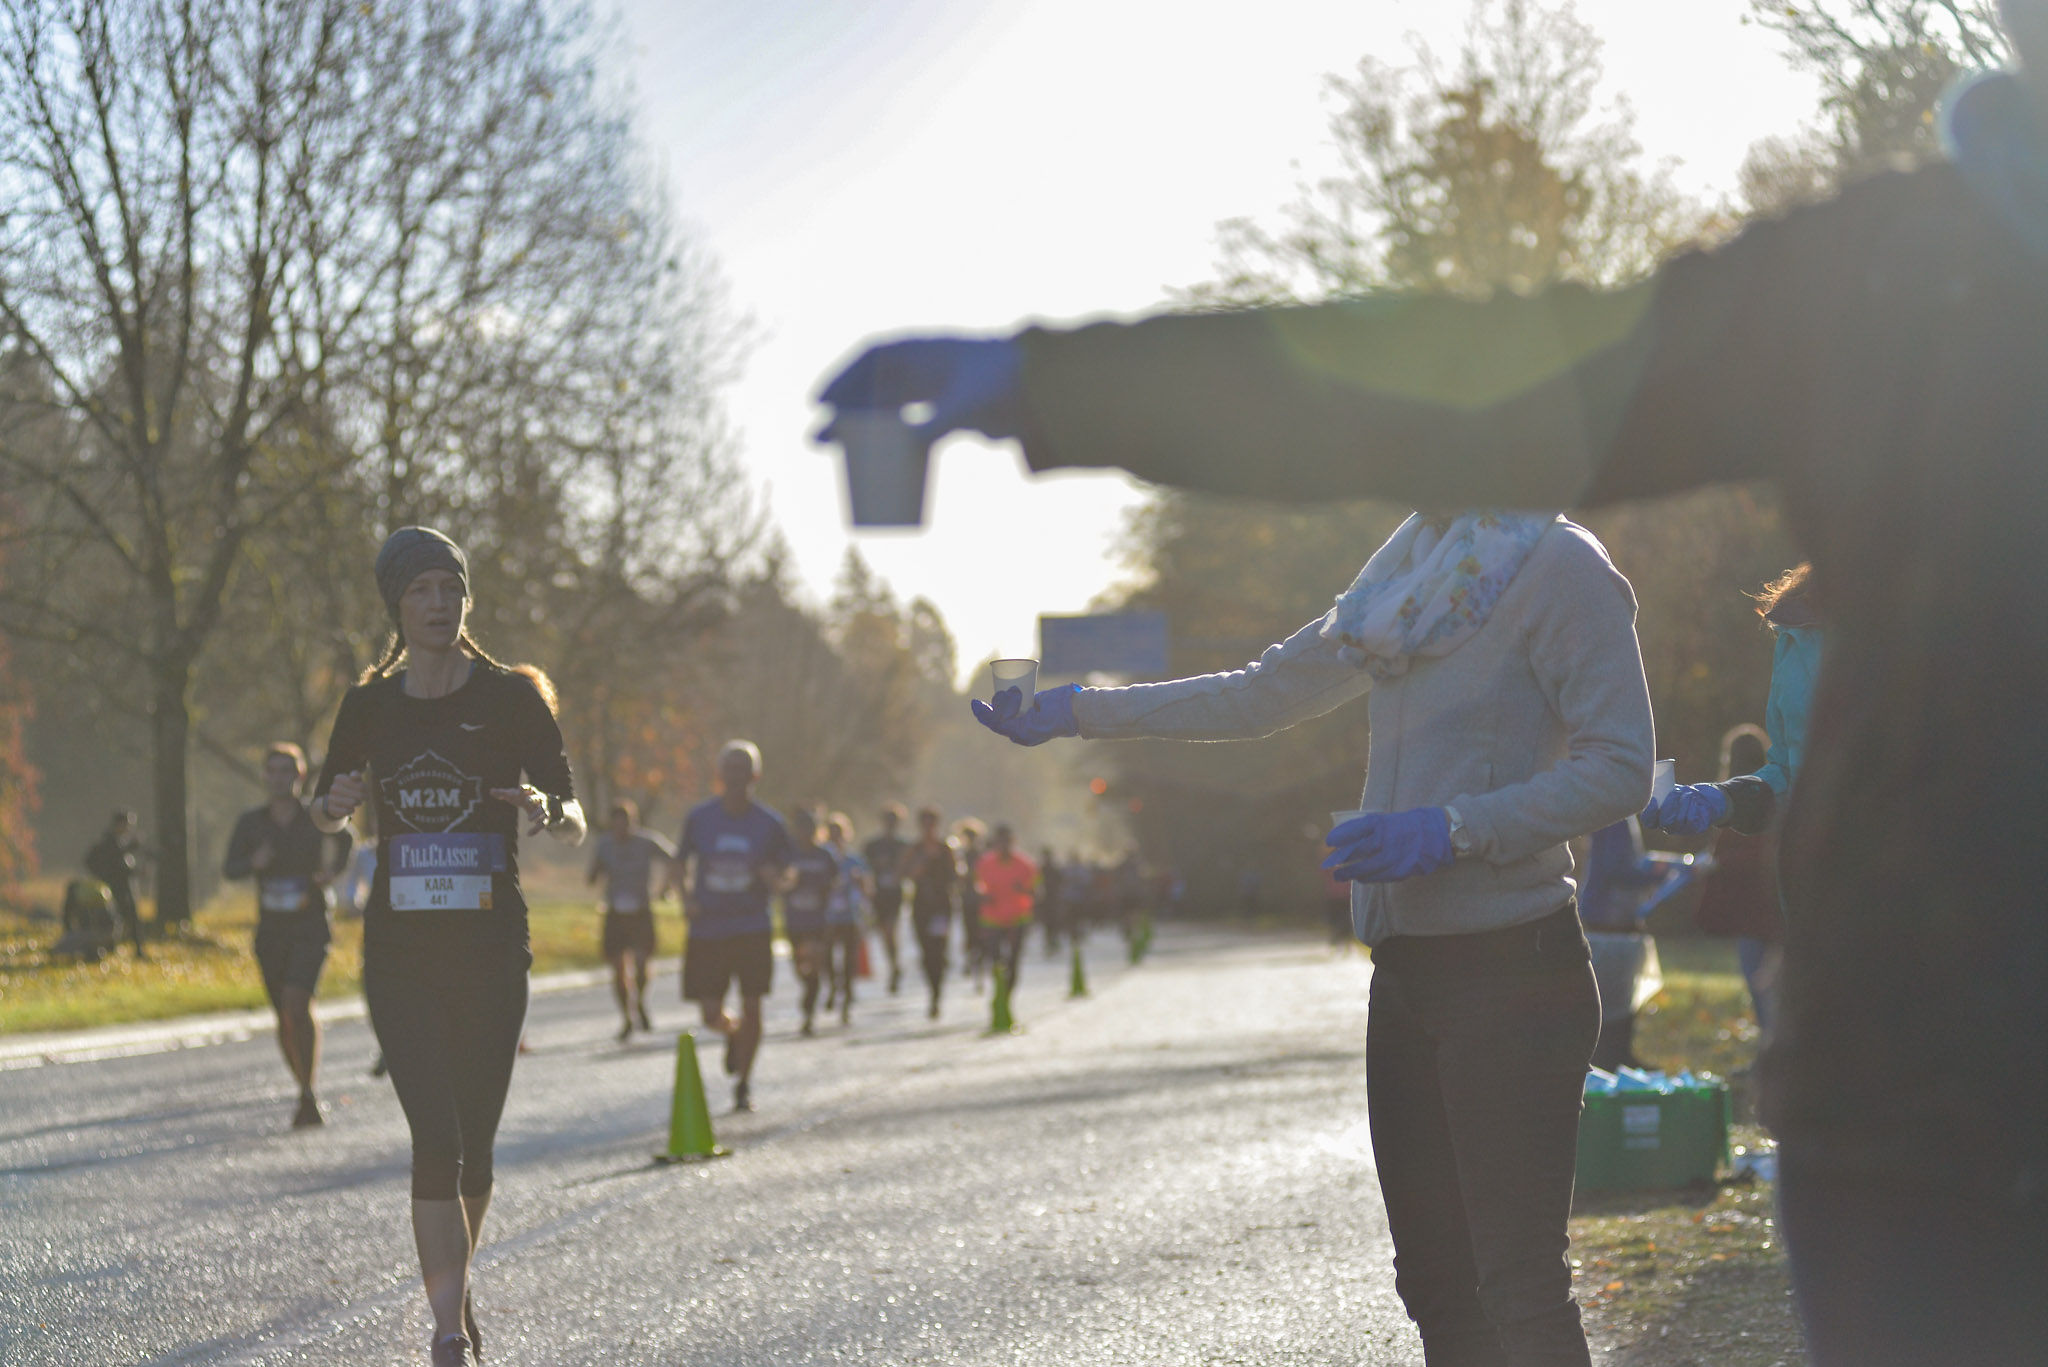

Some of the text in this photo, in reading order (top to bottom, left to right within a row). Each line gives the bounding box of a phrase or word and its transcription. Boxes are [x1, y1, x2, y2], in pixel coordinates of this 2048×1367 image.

[400, 788, 461, 808] M2M
[424, 878, 454, 891] KARA
[430, 894, 448, 905] 441
